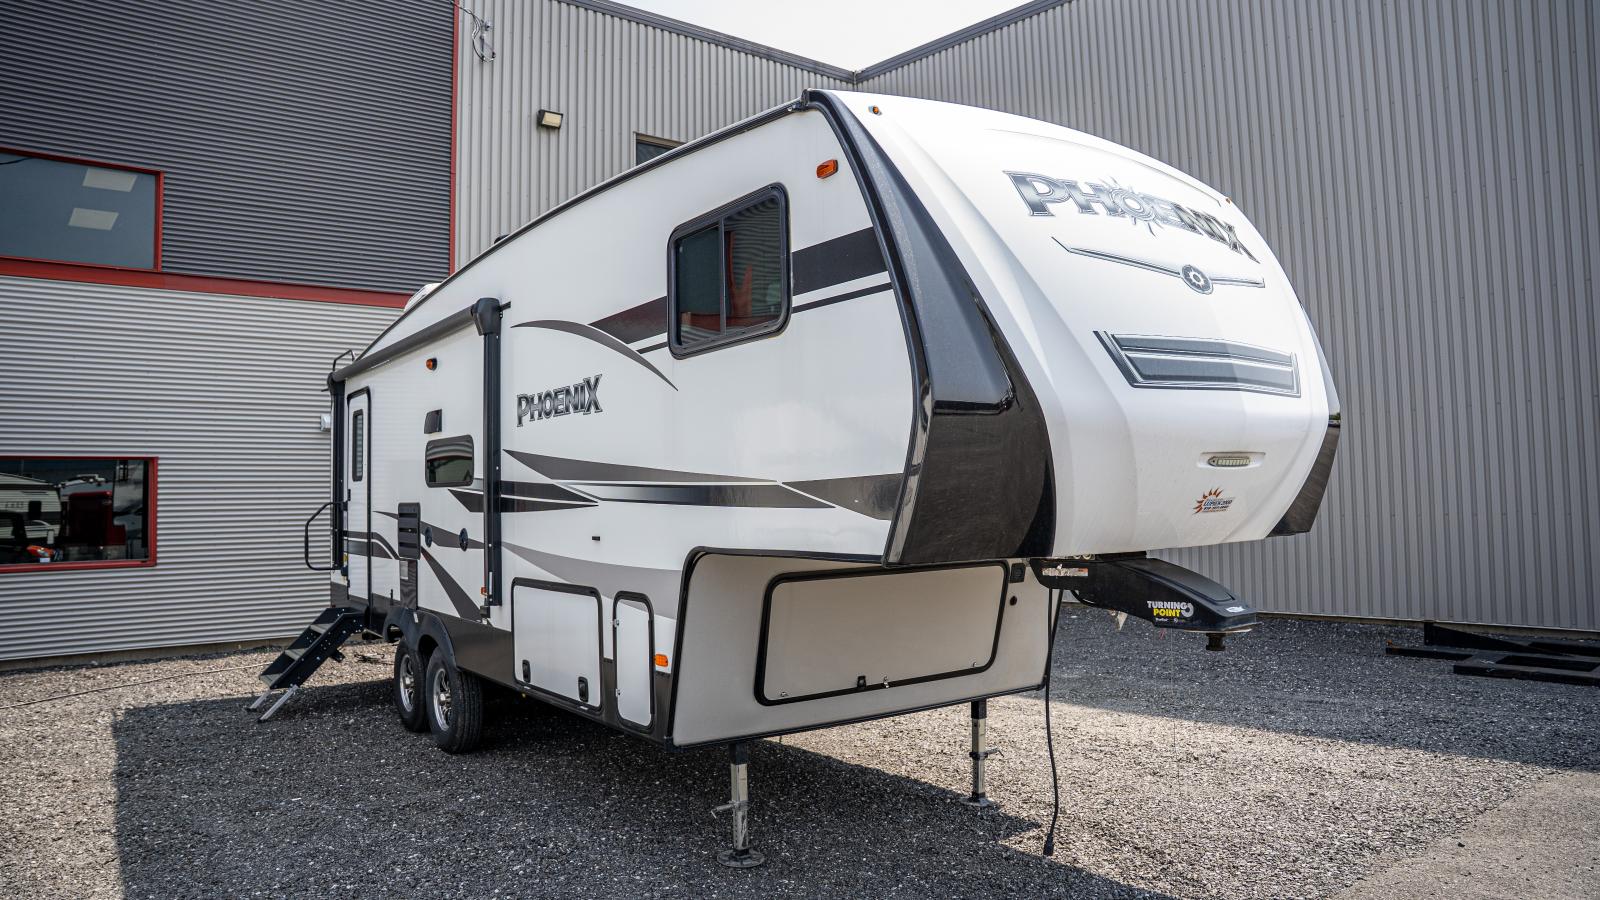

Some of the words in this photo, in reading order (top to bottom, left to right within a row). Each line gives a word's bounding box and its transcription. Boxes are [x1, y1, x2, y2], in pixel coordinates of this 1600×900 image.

[1003, 170, 1259, 263] PHOENIX
[517, 374, 603, 427] PHOENIX
[1147, 601, 1187, 609] TURNING
[1154, 608, 1180, 617] POINT
